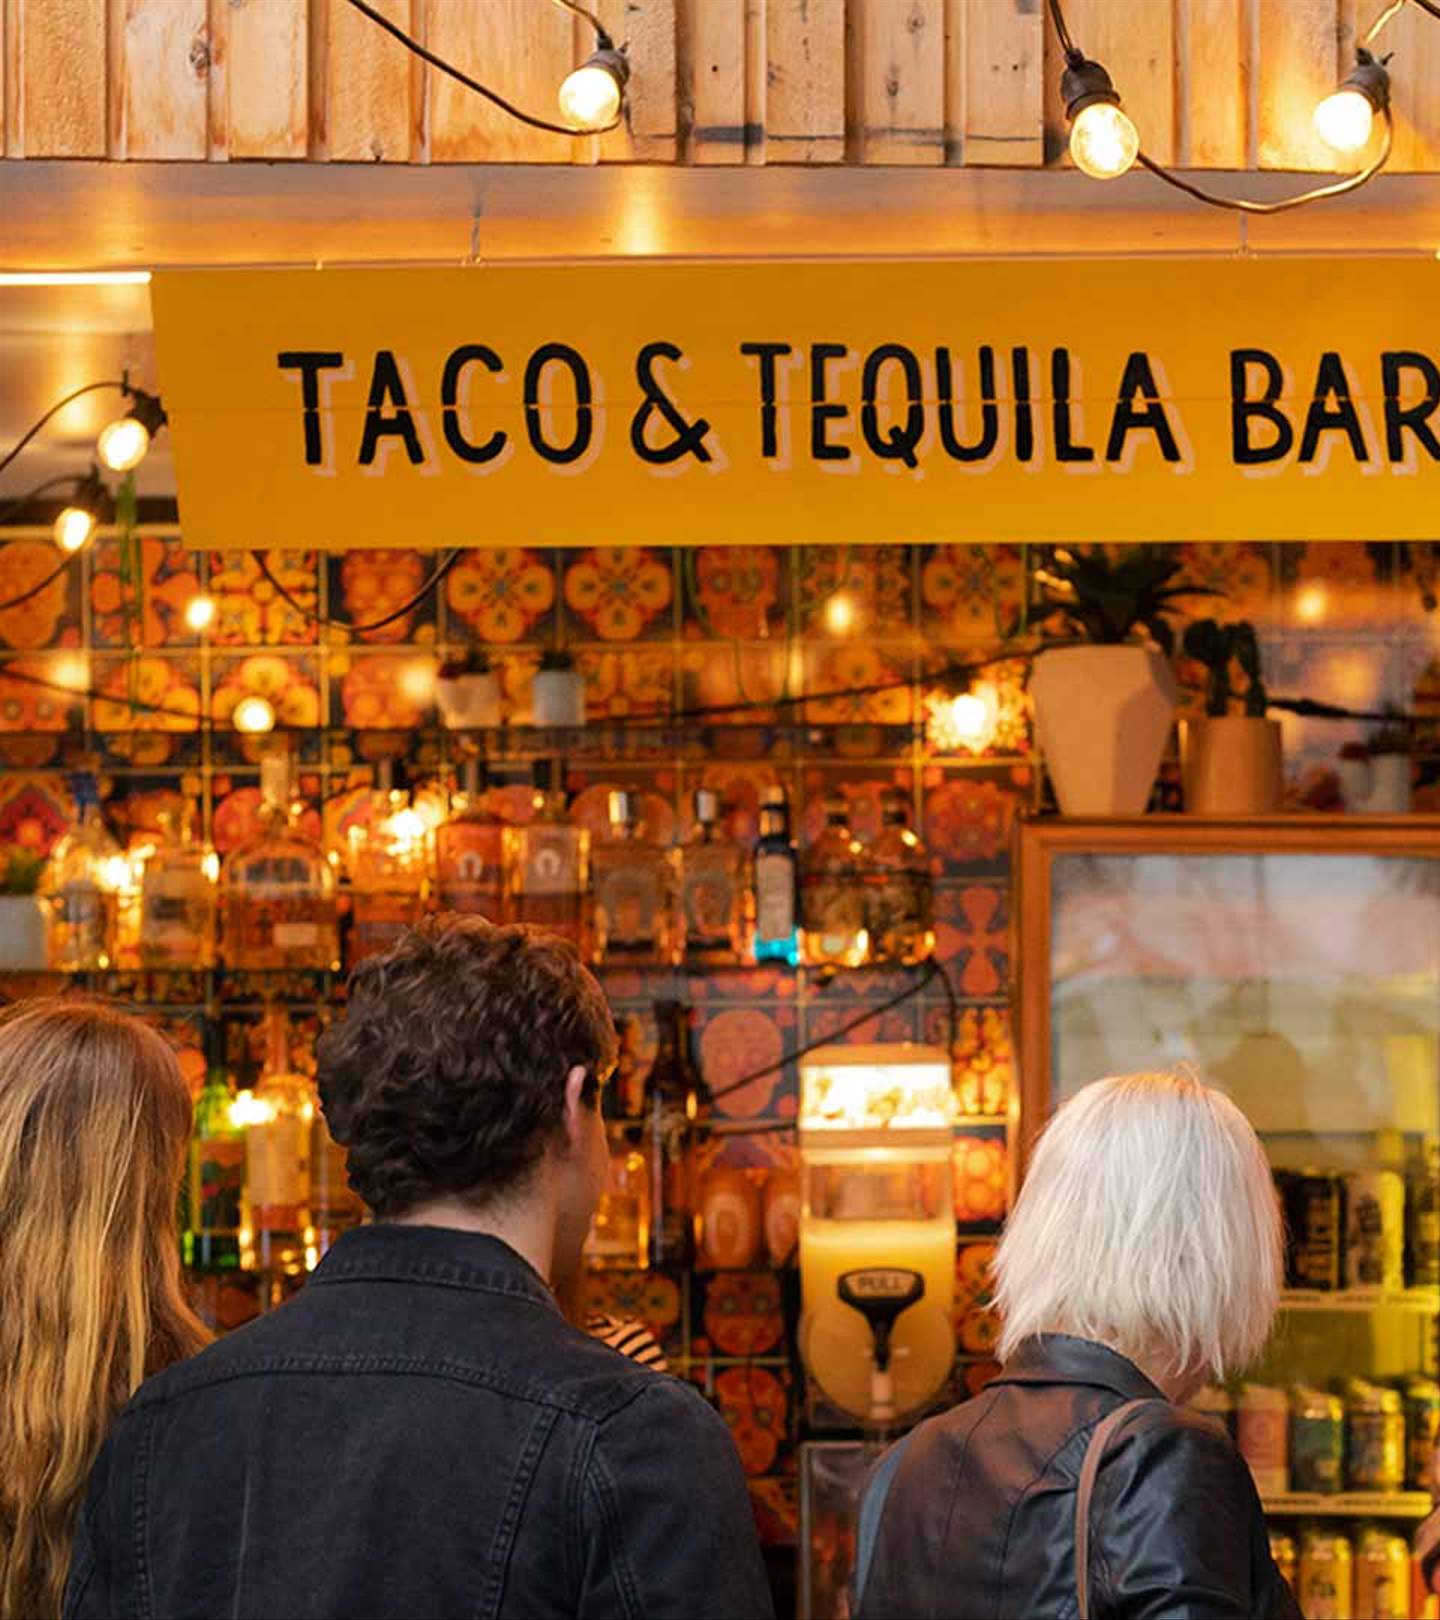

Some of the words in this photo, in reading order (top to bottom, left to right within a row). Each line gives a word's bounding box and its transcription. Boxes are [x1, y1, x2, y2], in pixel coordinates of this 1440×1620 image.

[277, 343, 596, 468] TACO
[630, 341, 714, 466] &
[740, 343, 1183, 470] TEQUILA
[858, 1275, 903, 1291] PULL
